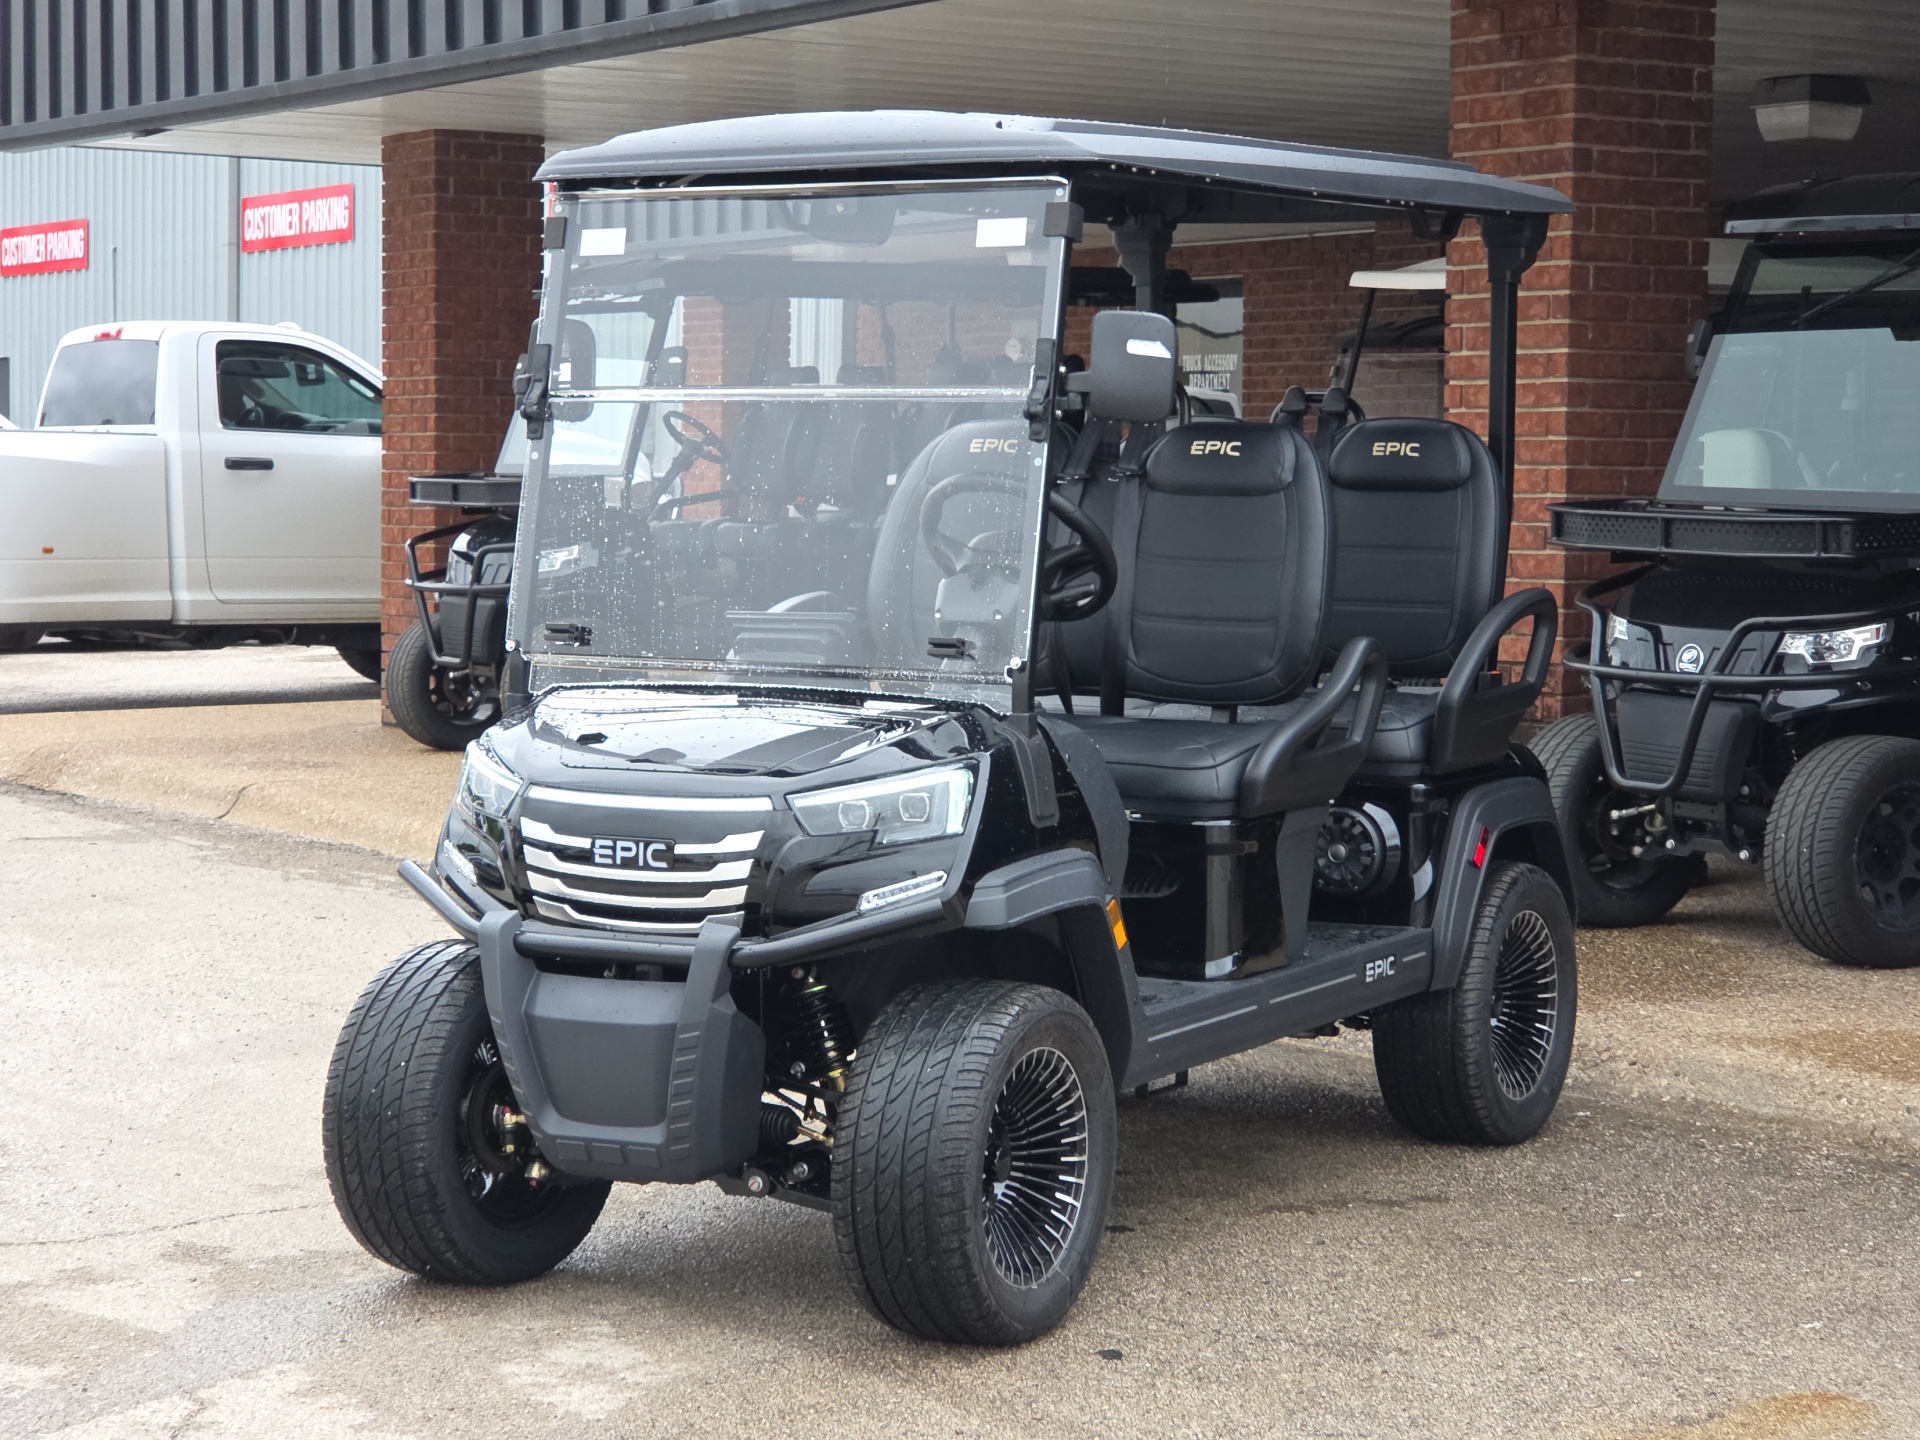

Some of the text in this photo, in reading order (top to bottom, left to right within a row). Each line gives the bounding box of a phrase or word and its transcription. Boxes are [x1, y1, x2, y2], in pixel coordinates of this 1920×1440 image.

[244, 195, 349, 241] CUSTOMER PARKING
[2, 228, 84, 267] CUSTOMER PARKING
[1182, 353, 1238, 372] TRUCK ACCESSORY
[1189, 373, 1231, 390] DEPARTMENT
[969, 438, 1018, 453] EPIC
[1190, 440, 1242, 456] EPIC
[1372, 442, 1420, 457] EPIC
[592, 838, 668, 868] EPIC
[1365, 955, 1395, 983] EPIC
